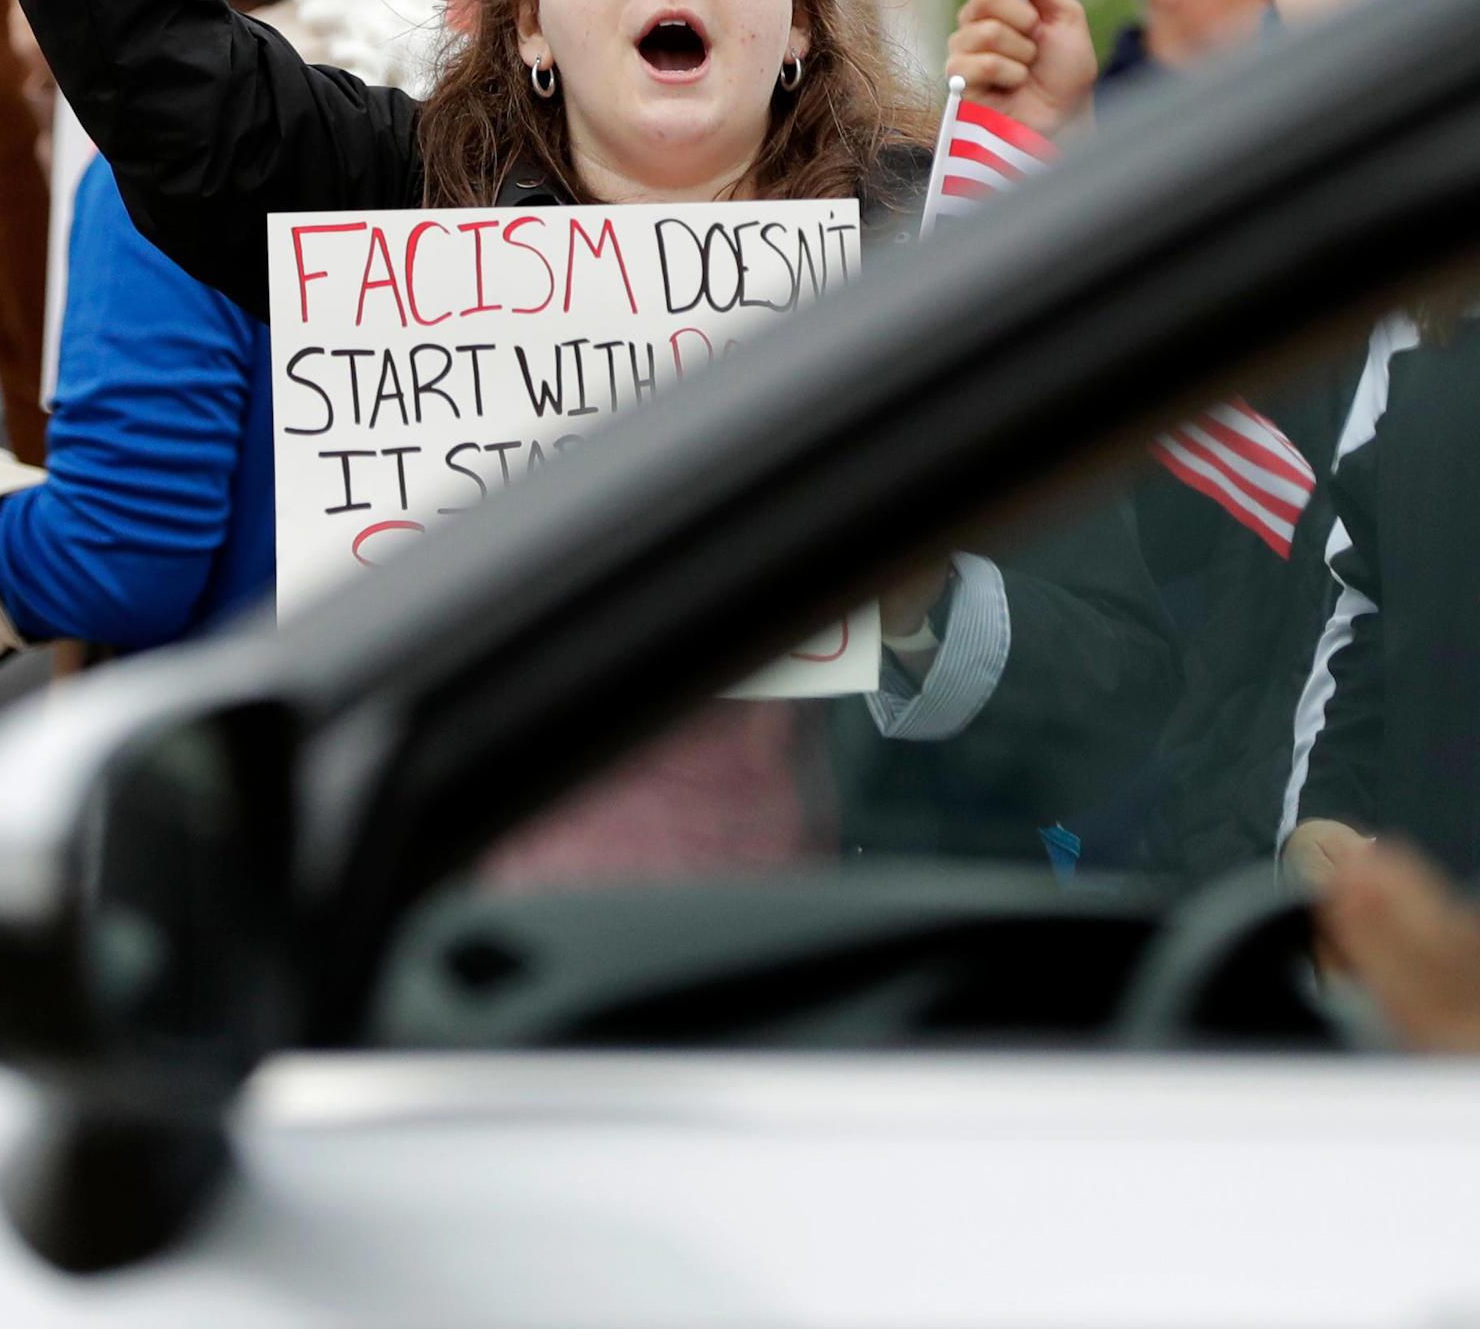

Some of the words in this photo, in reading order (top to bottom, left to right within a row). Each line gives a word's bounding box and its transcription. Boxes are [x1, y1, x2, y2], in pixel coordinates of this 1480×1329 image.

[290, 216, 638, 327] FACISM
[284, 342, 496, 435] START
[513, 338, 657, 417] WITH
[318, 446, 422, 515] IT
